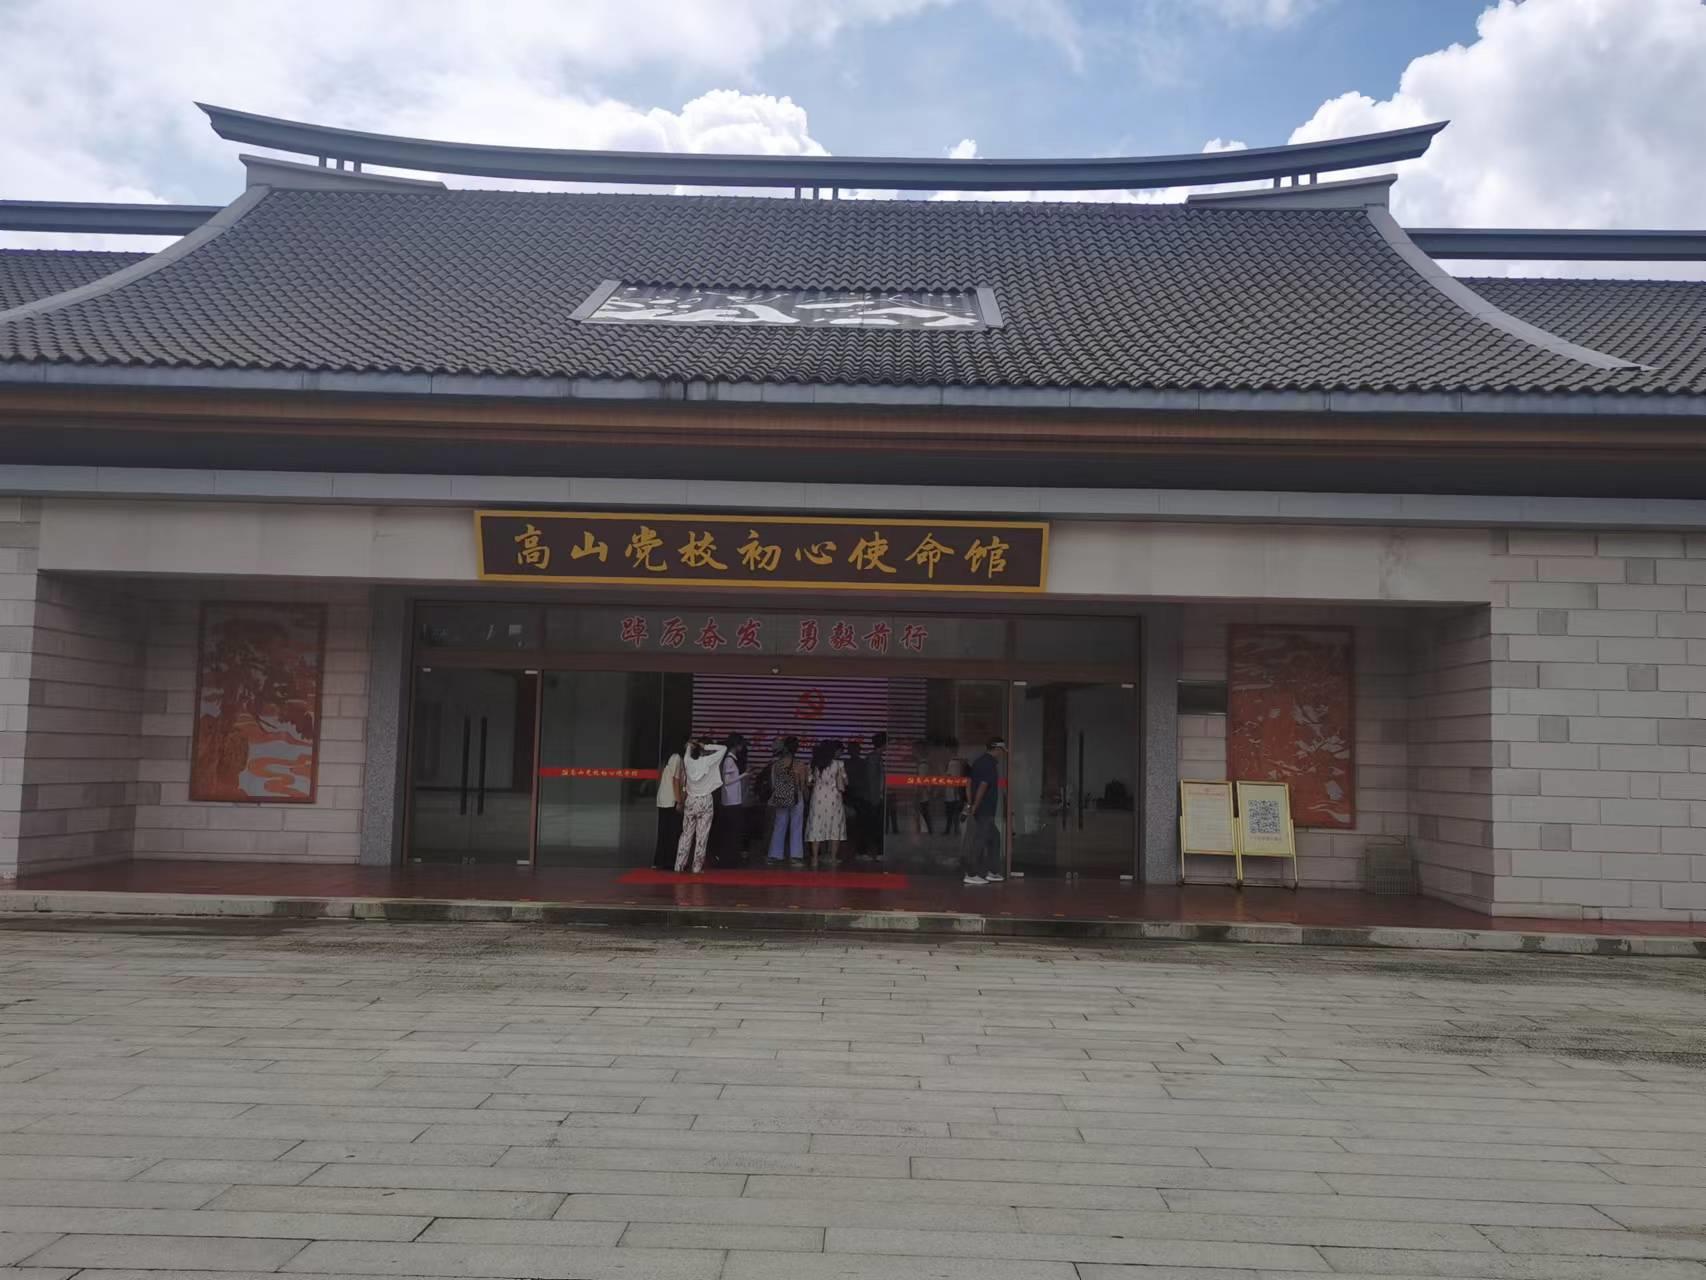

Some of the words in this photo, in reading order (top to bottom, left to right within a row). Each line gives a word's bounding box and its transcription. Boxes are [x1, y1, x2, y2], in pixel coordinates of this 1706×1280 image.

[514, 524, 1011, 578] 高山党校初心使命馆
[620, 616, 764, 650] 踔厉奋发
[796, 619, 929, 653] 勇毅前行
